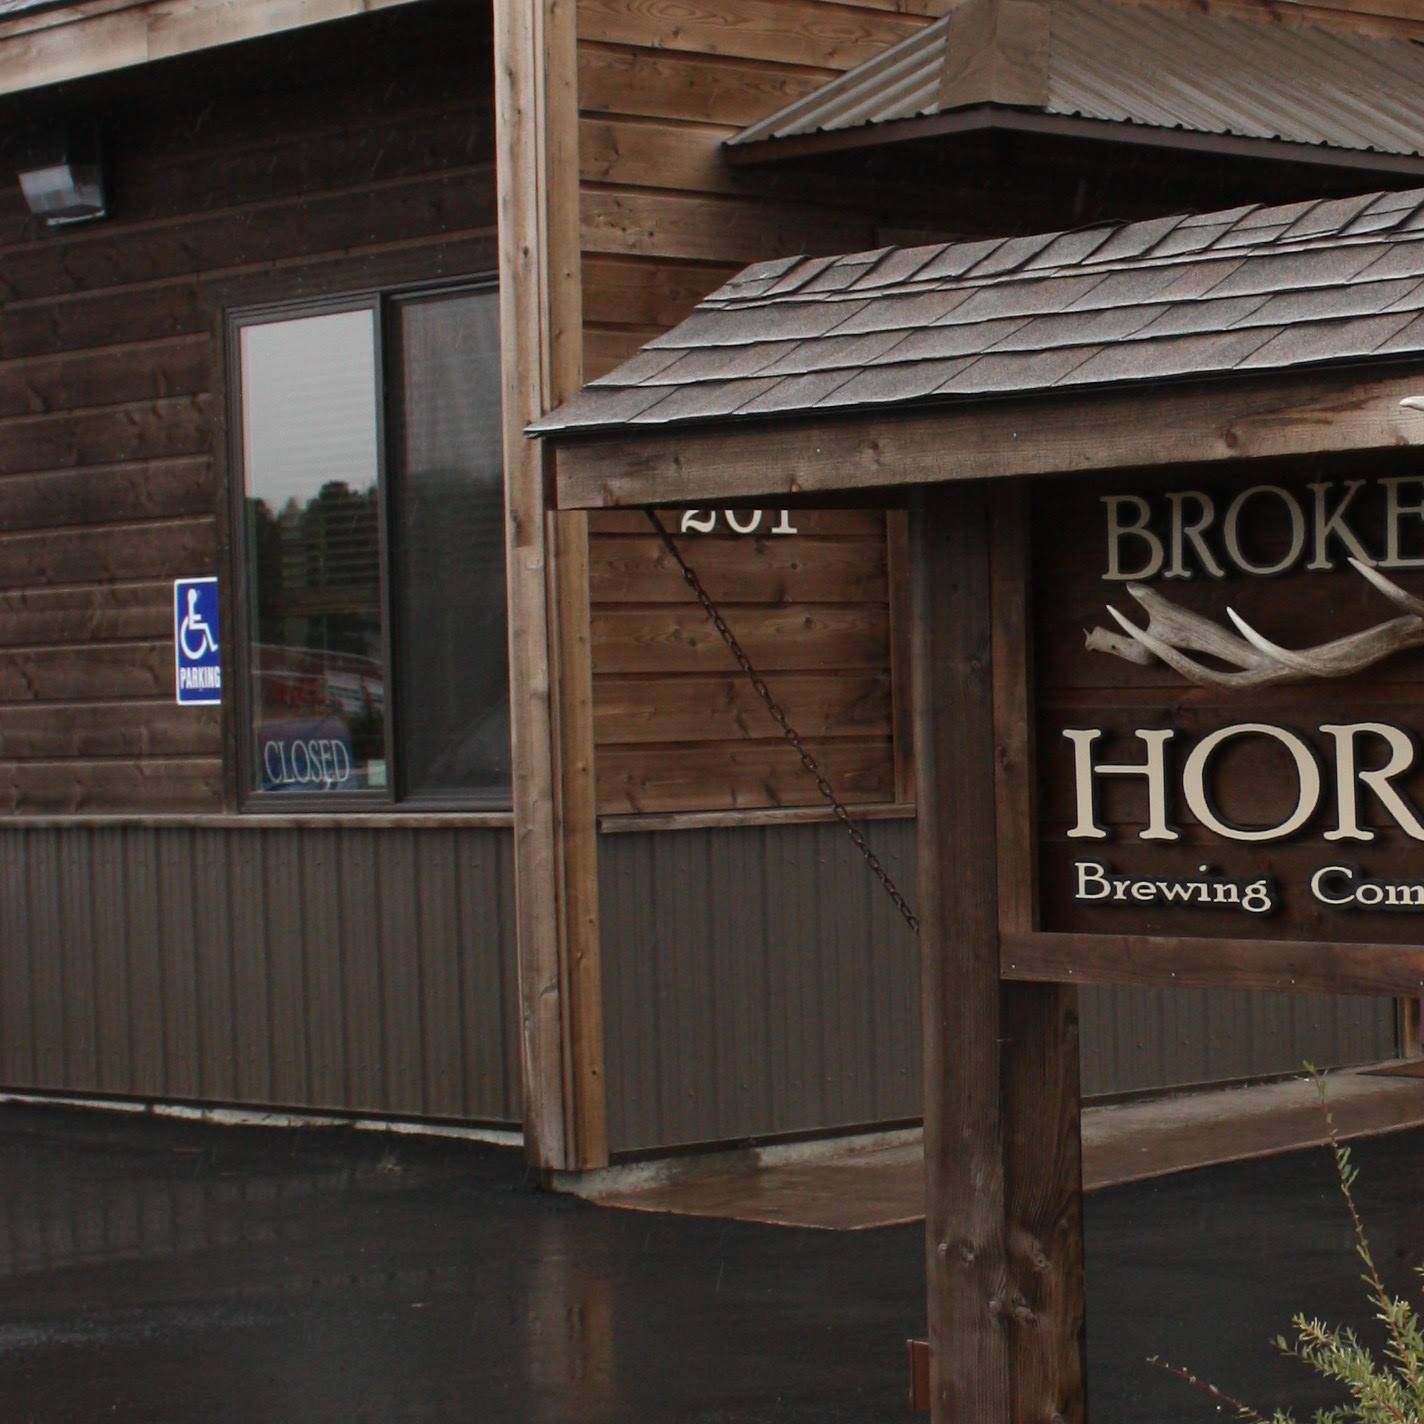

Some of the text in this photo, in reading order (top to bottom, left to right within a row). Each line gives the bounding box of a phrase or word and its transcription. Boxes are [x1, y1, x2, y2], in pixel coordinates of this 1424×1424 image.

[179, 666, 221, 689] PARKING
[264, 739, 349, 784] CLOSED
[1074, 862, 1272, 913] Brewing
